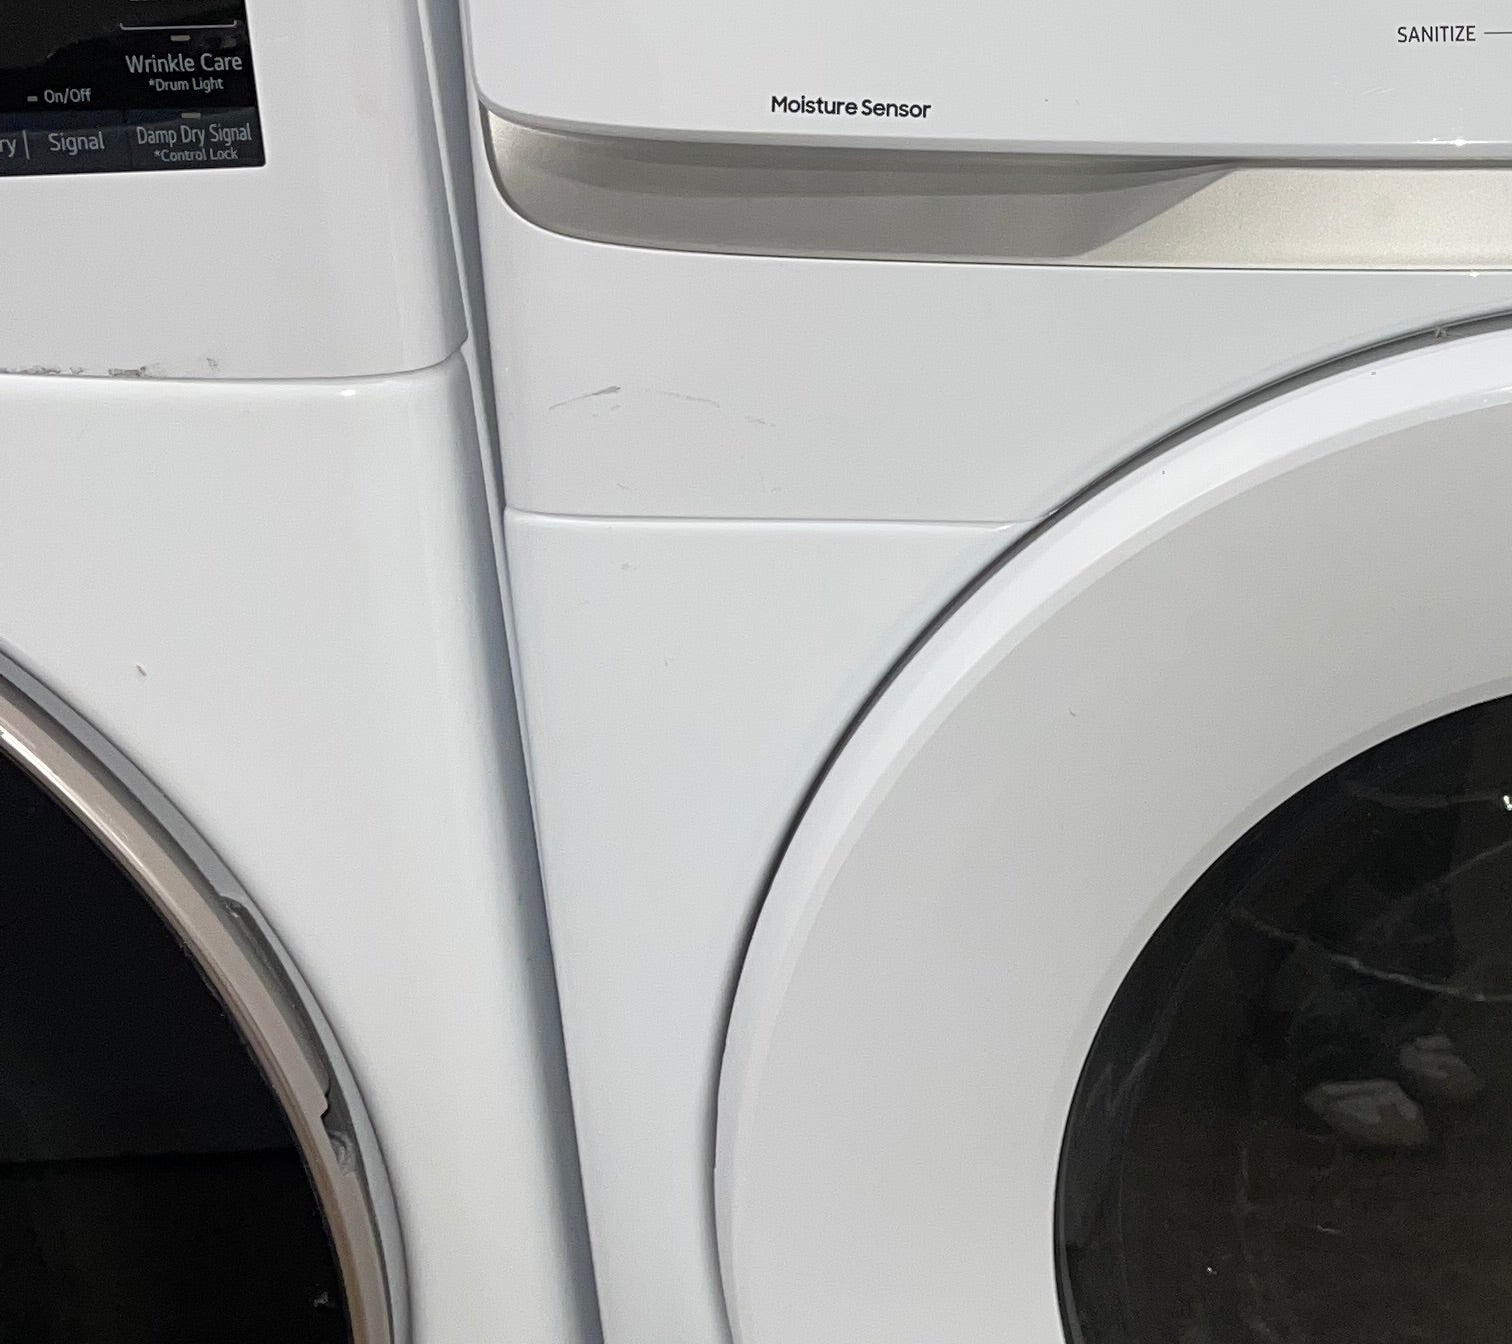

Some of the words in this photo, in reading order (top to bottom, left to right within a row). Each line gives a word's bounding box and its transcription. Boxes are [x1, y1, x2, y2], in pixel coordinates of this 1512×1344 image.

[1397, 25, 1476, 43] SANITIZE
[124, 53, 196, 74] Wrinkle
[200, 52, 243, 72] Care
[191, 76, 225, 94] Light
[43, 87, 92, 104] On/Off
[771, 95, 859, 116] Moisture
[860, 98, 932, 119] Sensor
[47, 130, 105, 156] Signal
[136, 125, 177, 148] Damp
[179, 124, 206, 147] Dry
[208, 122, 253, 147] Signal
[209, 146, 239, 161] Lock
